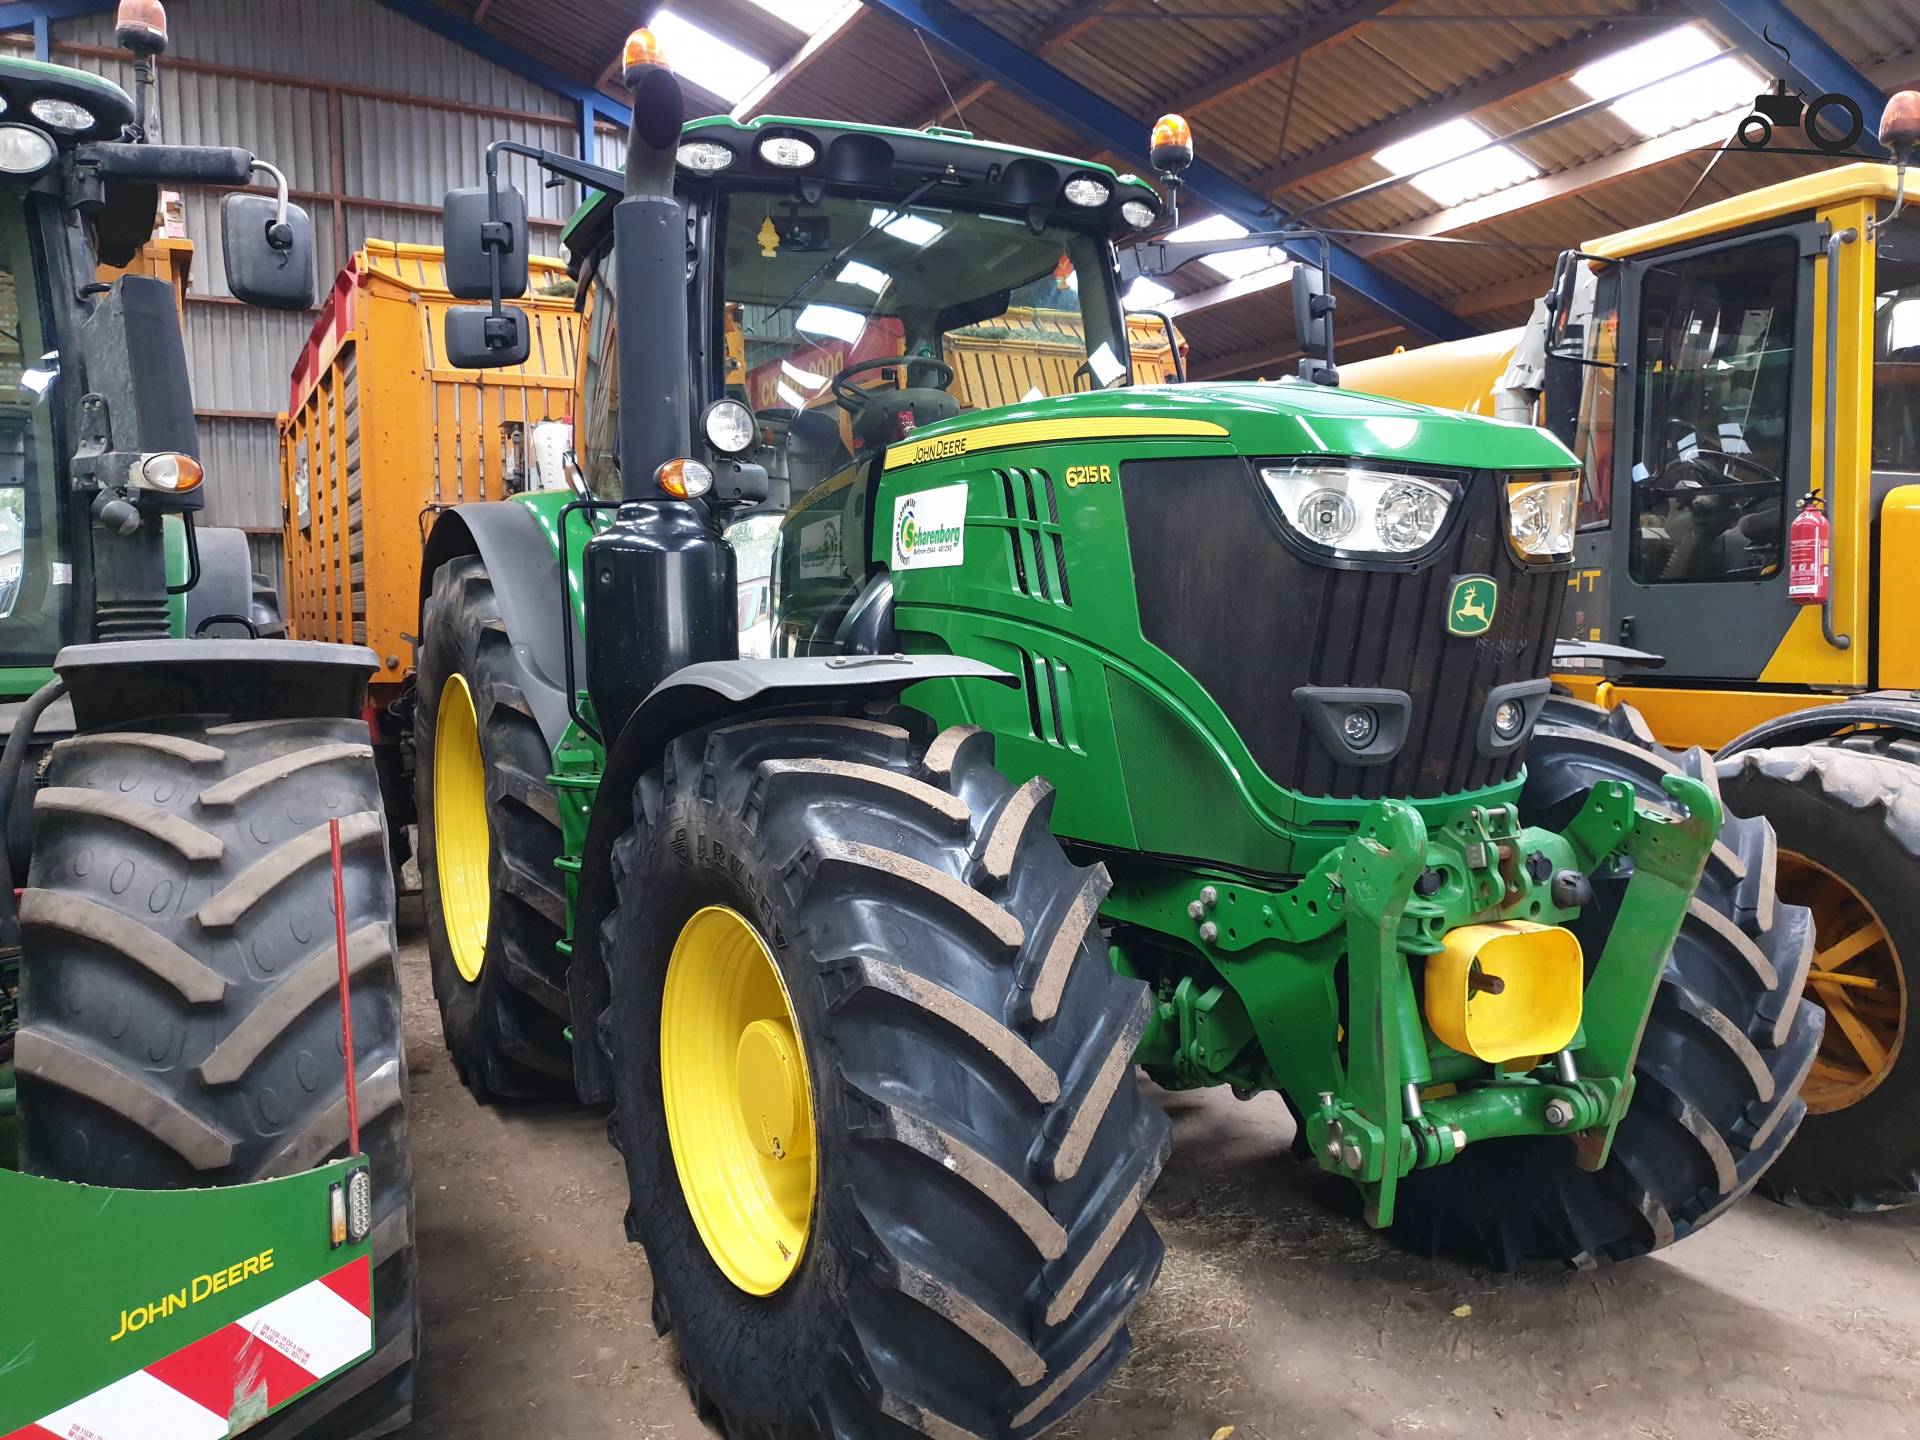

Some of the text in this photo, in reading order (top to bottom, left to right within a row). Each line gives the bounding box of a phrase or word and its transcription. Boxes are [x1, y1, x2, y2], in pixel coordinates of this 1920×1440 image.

[913, 438, 967, 461] JOHN DEERE
[905, 522, 961, 548] Scharenborg
[110, 1247, 274, 1342] JOHN DEERE
